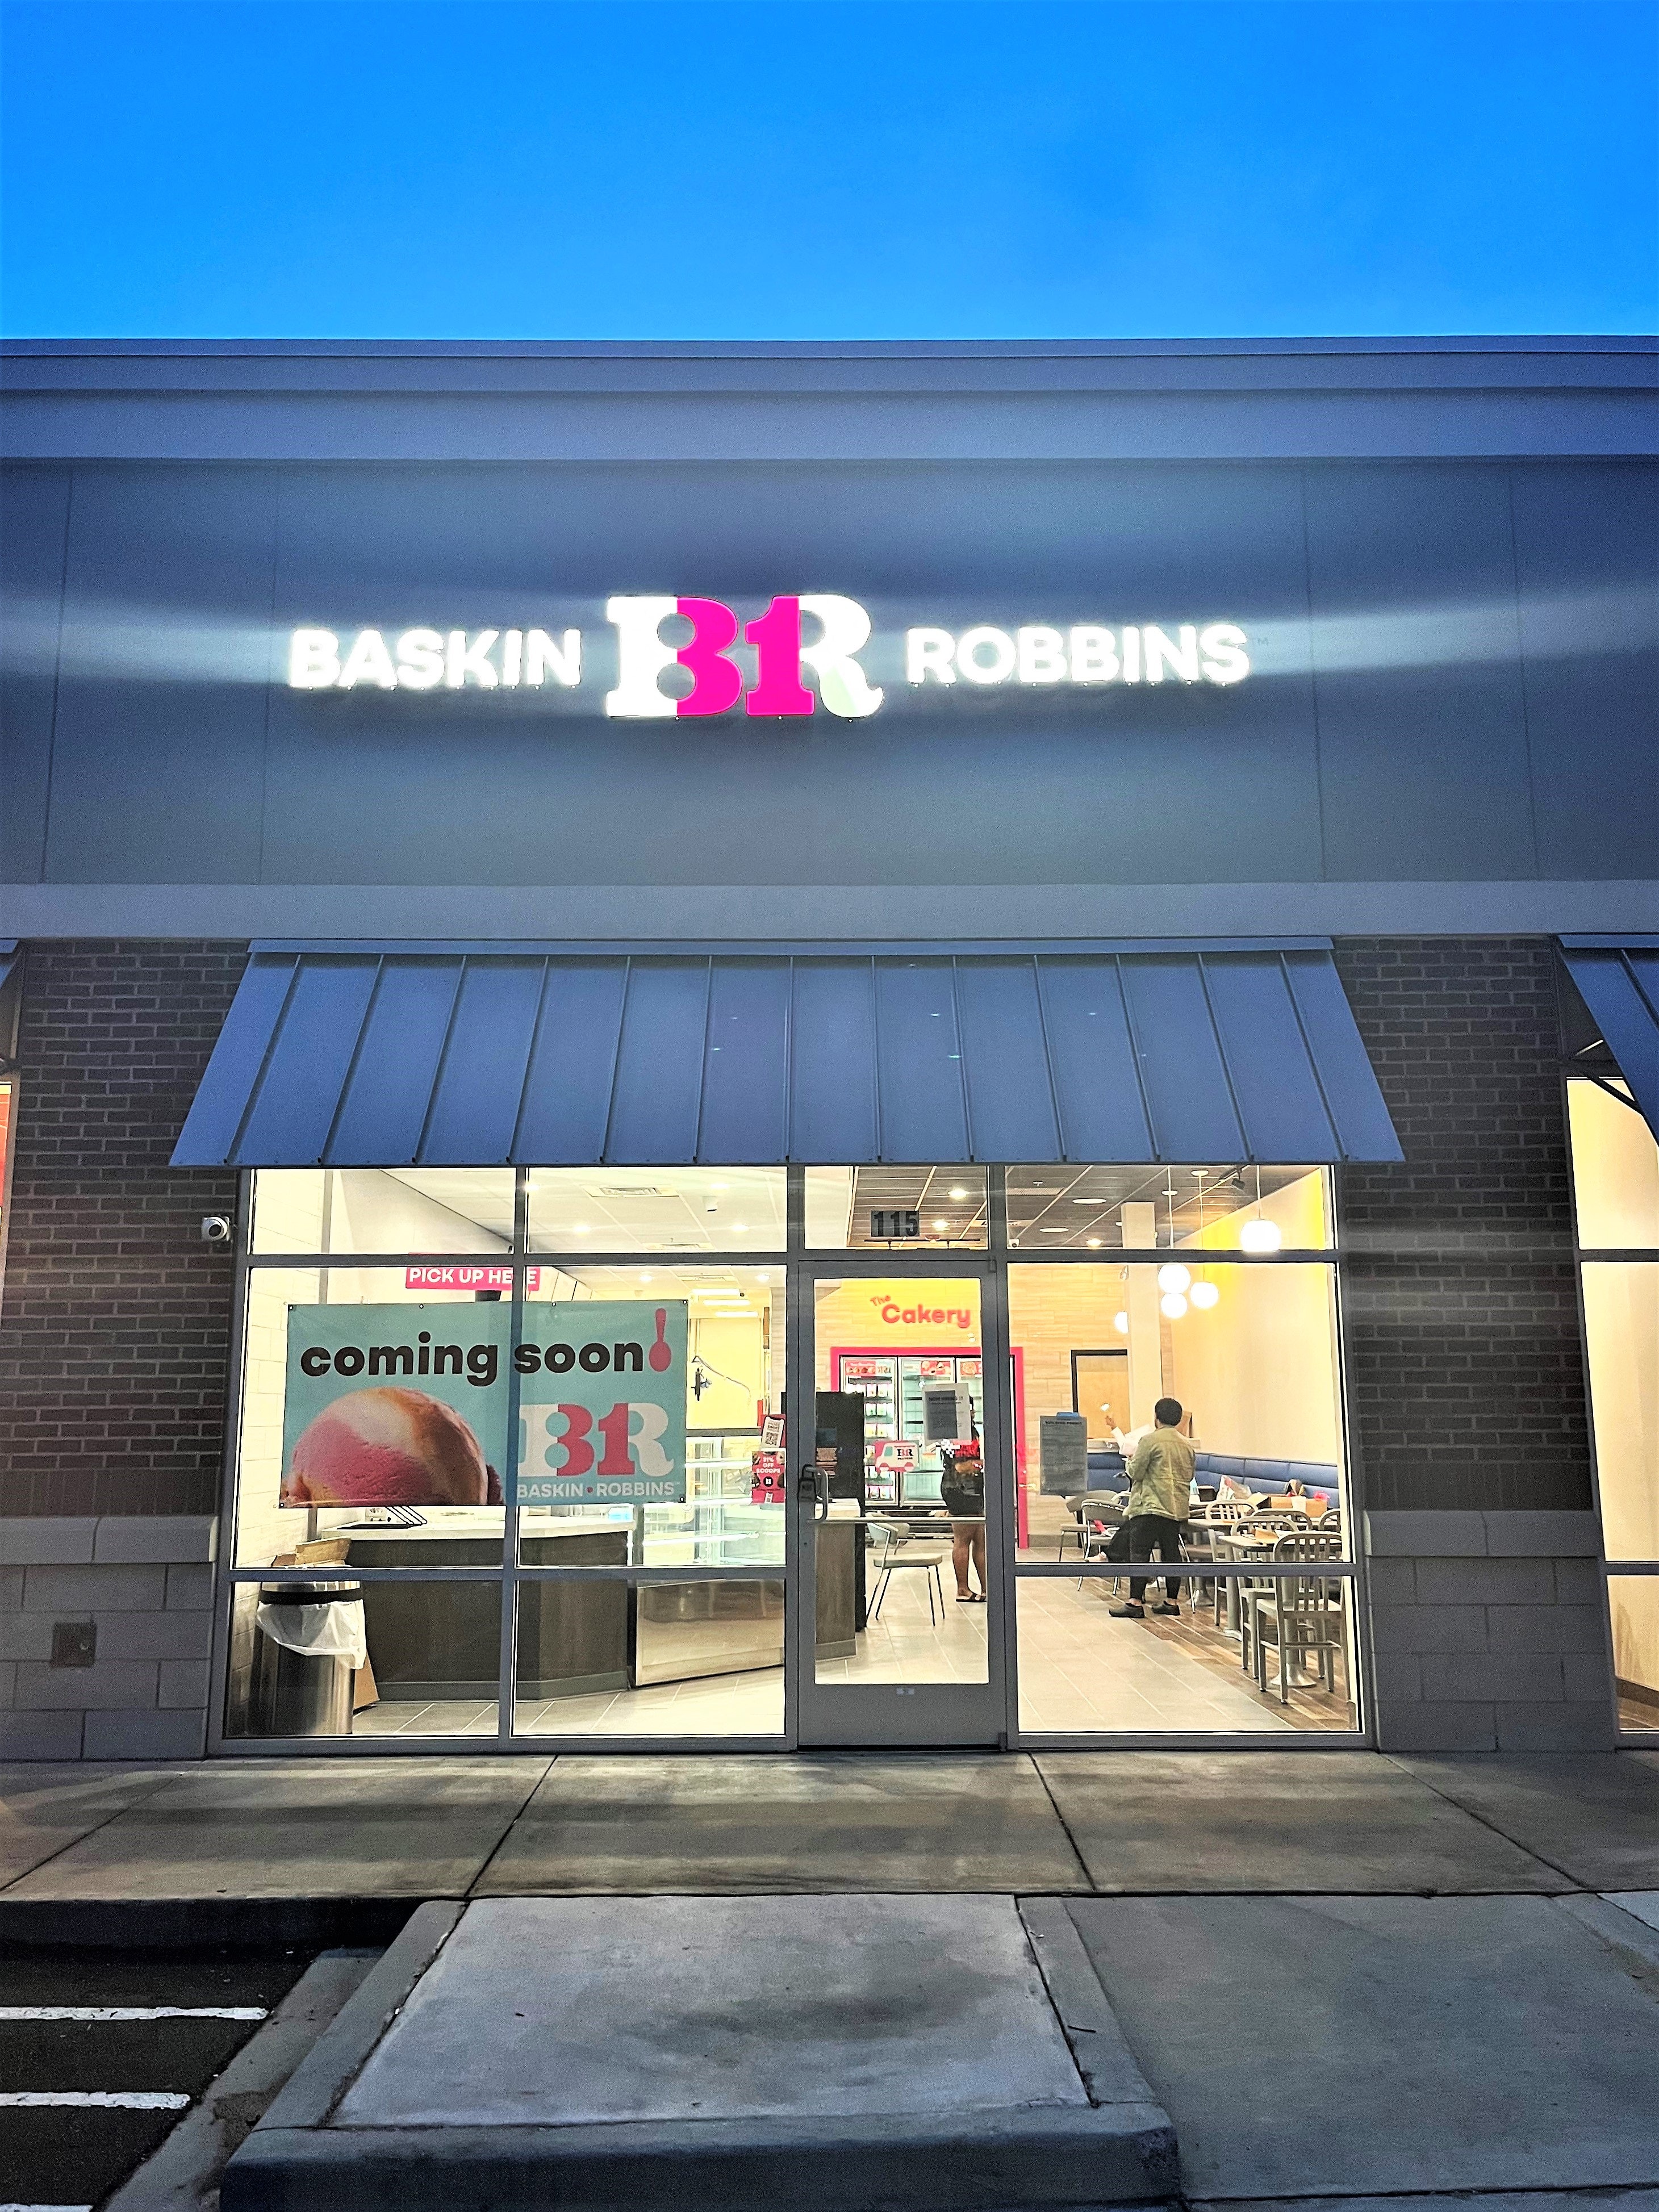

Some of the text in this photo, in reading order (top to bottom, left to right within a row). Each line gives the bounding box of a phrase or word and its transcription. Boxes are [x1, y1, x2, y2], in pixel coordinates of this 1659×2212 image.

[290, 629, 582, 688] BASKIN
[908, 624, 1251, 685] ROBBINS
[874, 1211, 918, 1236] 115
[409, 1268, 537, 1285] PICK UP HEE
[870, 1295, 891, 1306] The
[881, 1303, 971, 1329] Cakery
[300, 1331, 499, 1387] coming
[517, 1481, 674, 1498] BASKIN ROBBINS
